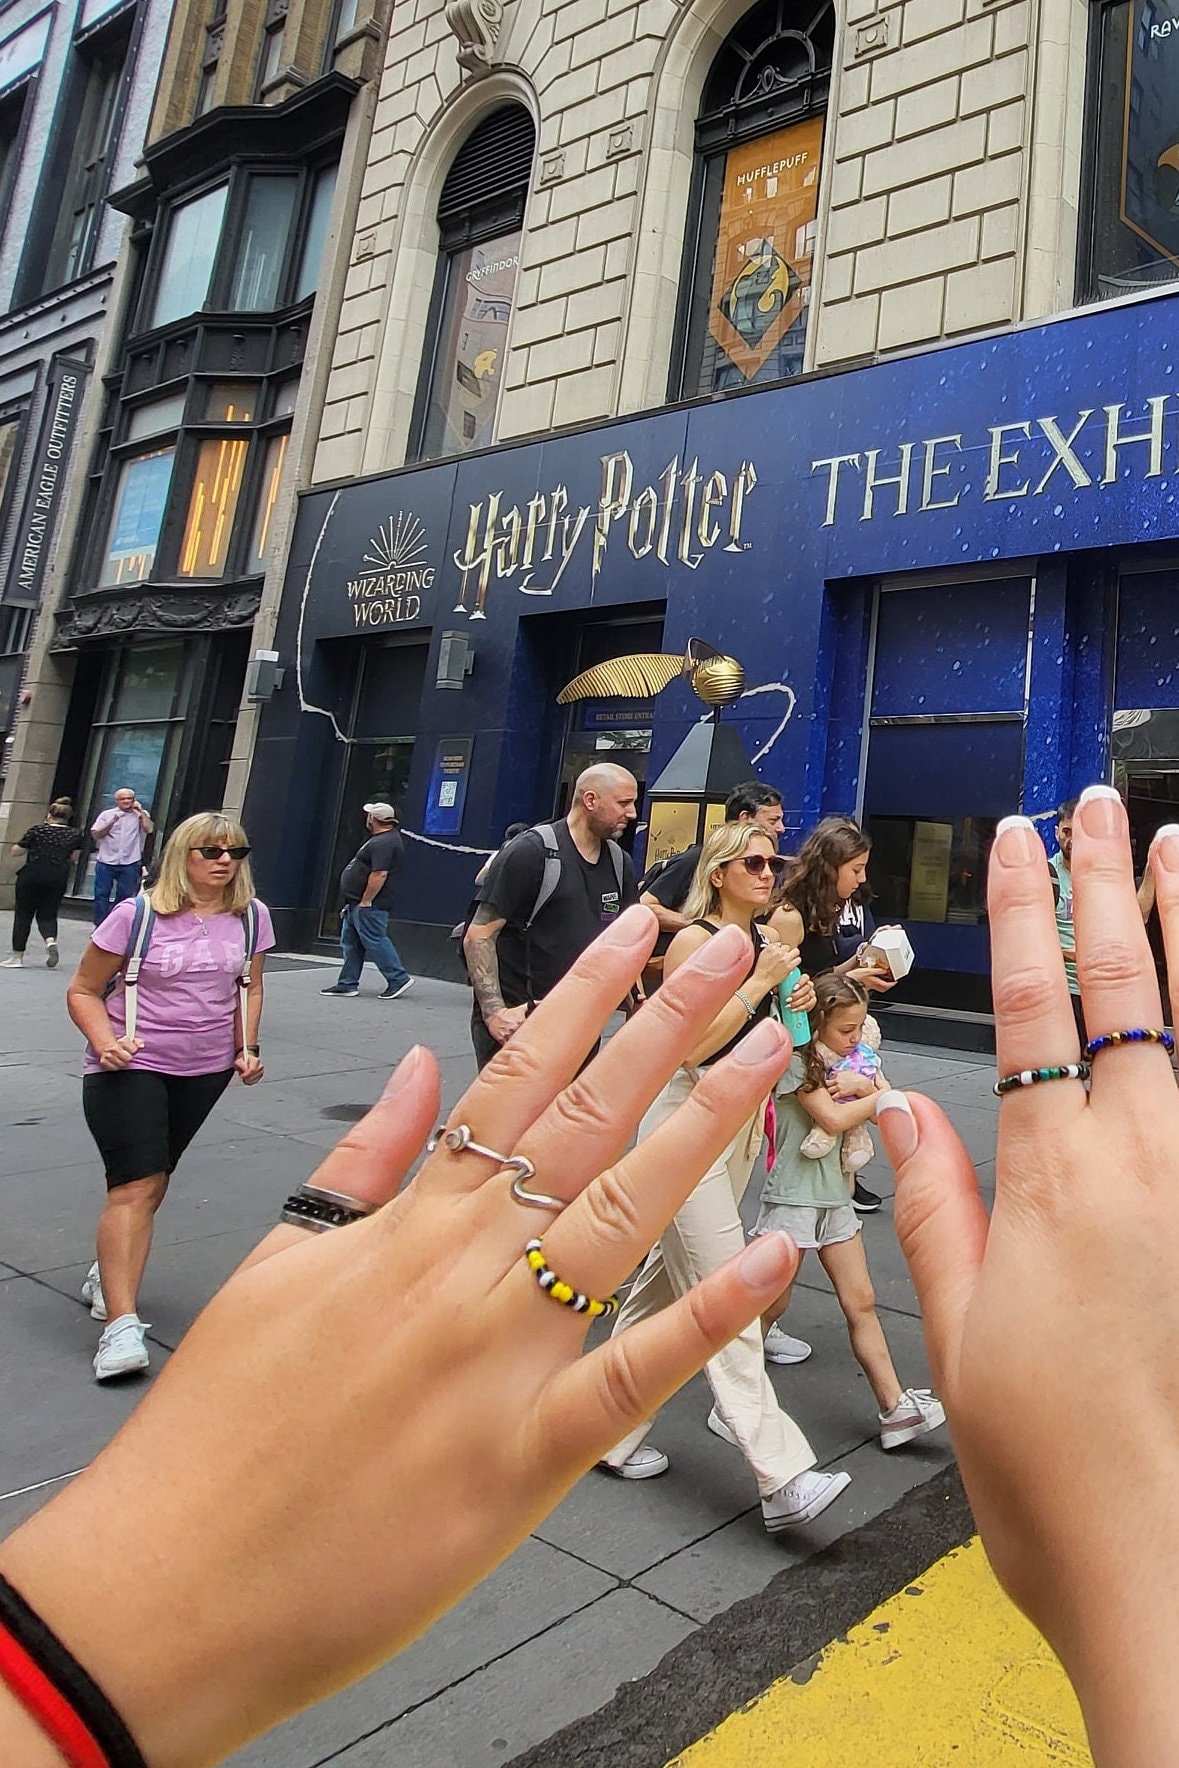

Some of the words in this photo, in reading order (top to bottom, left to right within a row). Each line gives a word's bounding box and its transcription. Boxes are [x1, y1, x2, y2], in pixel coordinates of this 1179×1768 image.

[736, 152, 808, 187] HUFFLEPUFF
[465, 256, 520, 282] GRYFFINDOR
[46, 373, 77, 459] OUTFITTERS
[36, 463, 59, 511] EAGLE
[810, 433, 963, 528] THE
[17, 512, 48, 591] AMERICAN
[453, 482, 591, 620] Harry
[590, 450, 758, 605] Potter
[346, 567, 436, 600] WIZARDING
[353, 595, 421, 627] WORLD
